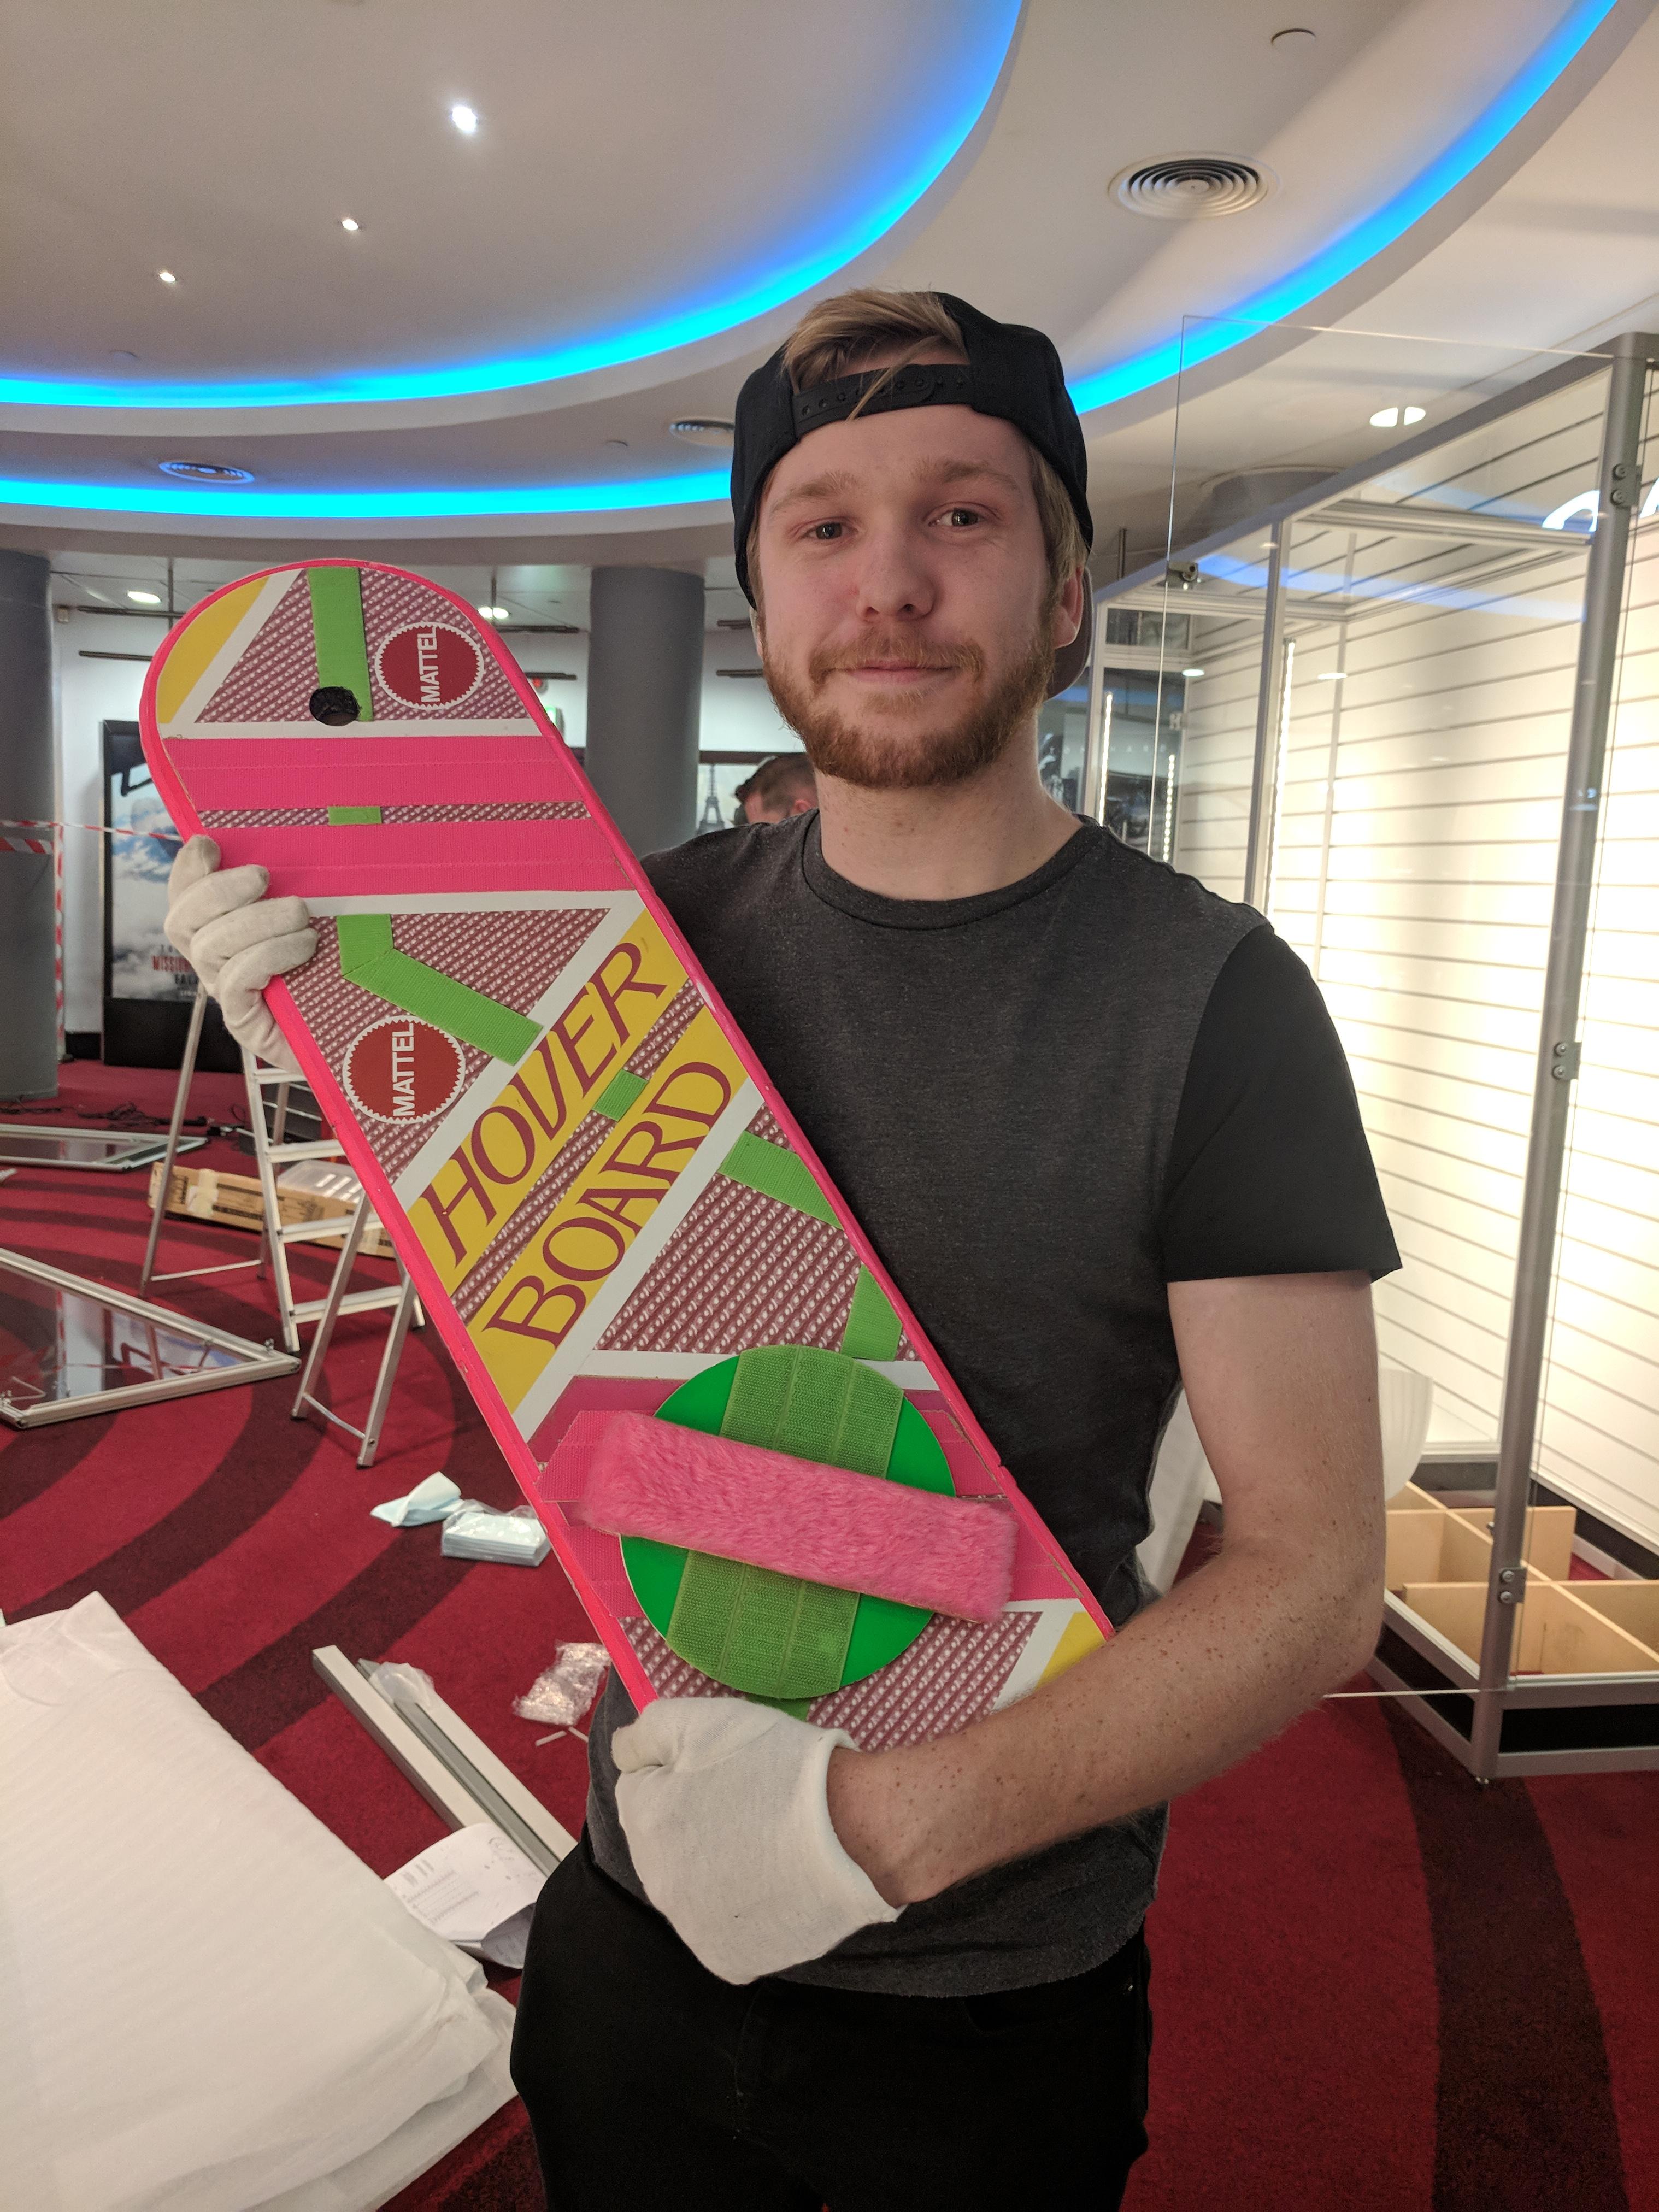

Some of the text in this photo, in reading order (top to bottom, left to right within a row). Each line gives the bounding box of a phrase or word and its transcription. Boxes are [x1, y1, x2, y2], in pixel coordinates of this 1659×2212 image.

[417, 627, 441, 702] MATTEL
[391, 1022, 415, 1116] MATTEL
[420, 942, 667, 1268] HOVER
[483, 1062, 732, 1349] BOARD
